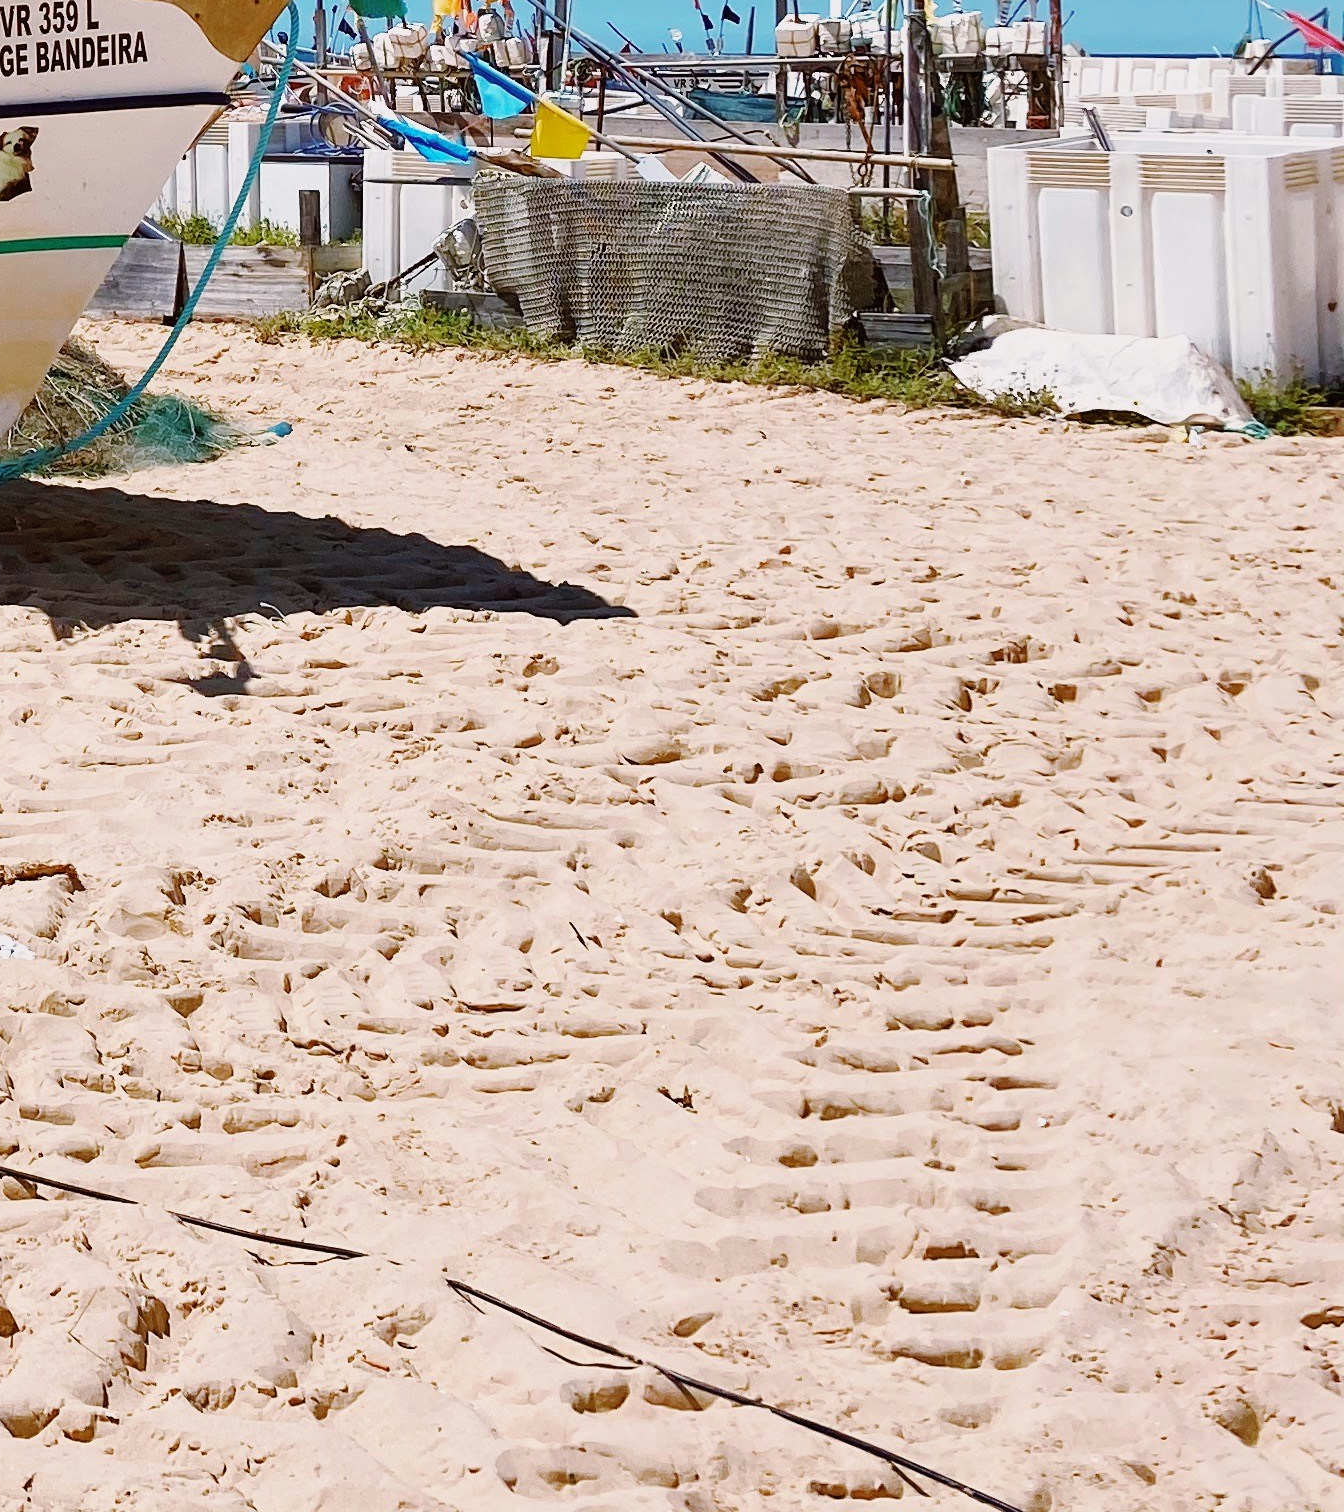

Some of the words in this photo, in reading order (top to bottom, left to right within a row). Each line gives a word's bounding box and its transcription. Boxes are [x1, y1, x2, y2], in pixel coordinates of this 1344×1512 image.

[0, 4, 33, 37] VR
[39, 0, 79, 35] 359
[36, 31, 148, 74] BANDEIRA
[673, 79, 687, 88] VR
